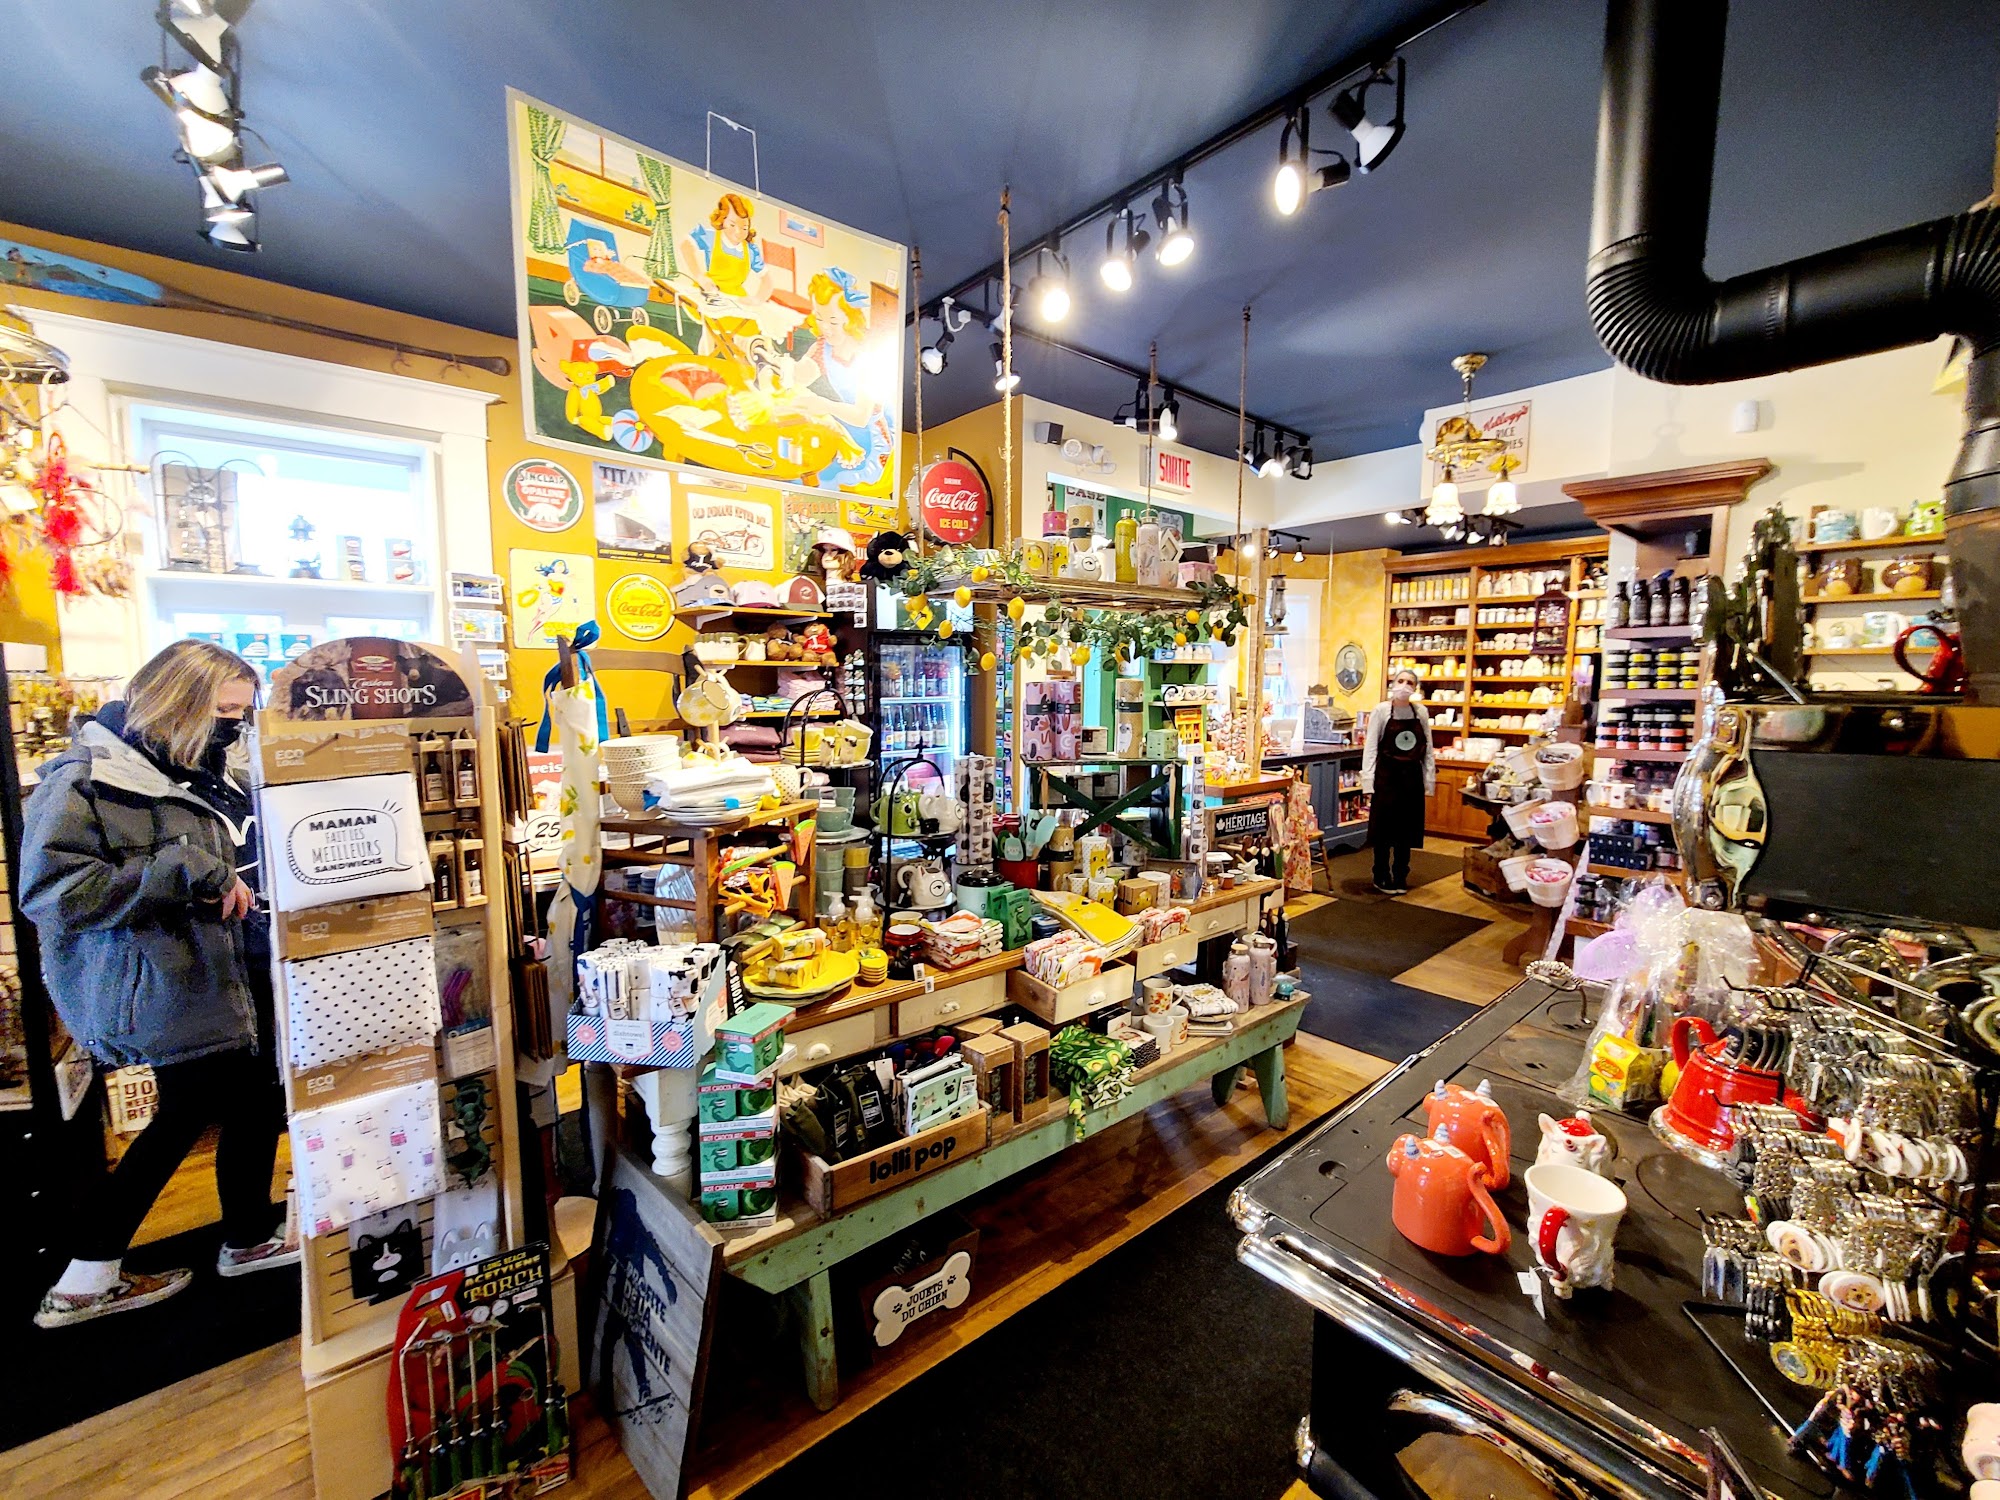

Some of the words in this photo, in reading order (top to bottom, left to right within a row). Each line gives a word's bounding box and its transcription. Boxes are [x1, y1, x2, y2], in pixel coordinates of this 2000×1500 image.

[1495, 426, 1516, 438] RICE
[518, 468, 565, 485] SINCLAIR
[599, 465, 649, 485] TITAN
[1159, 452, 1191, 488] SORTIE
[939, 518, 951, 529] ICE
[952, 518, 969, 530] COLD
[304, 685, 370, 708] SLING
[373, 684, 437, 706] SHOTS
[275, 748, 305, 760] ECO
[309, 814, 378, 832] MAMAN
[1225, 811, 1267, 830] HÉRITAGE
[325, 829, 347, 844] FAIT
[349, 827, 366, 841] LES
[311, 839, 382, 864] MEILLEURS
[314, 857, 383, 873] SANDWICHS
[301, 921, 329, 934] ECO
[306, 1073, 335, 1089] ECO
[869, 1146, 911, 1184] lolli
[914, 1135, 956, 1172] pop
[464, 1254, 541, 1287] ACETYLENE
[463, 1265, 544, 1304] TORCH
[906, 1280, 944, 1307] JOUETS
[901, 1306, 916, 1323] DU
[918, 1288, 948, 1313] CHIEN
